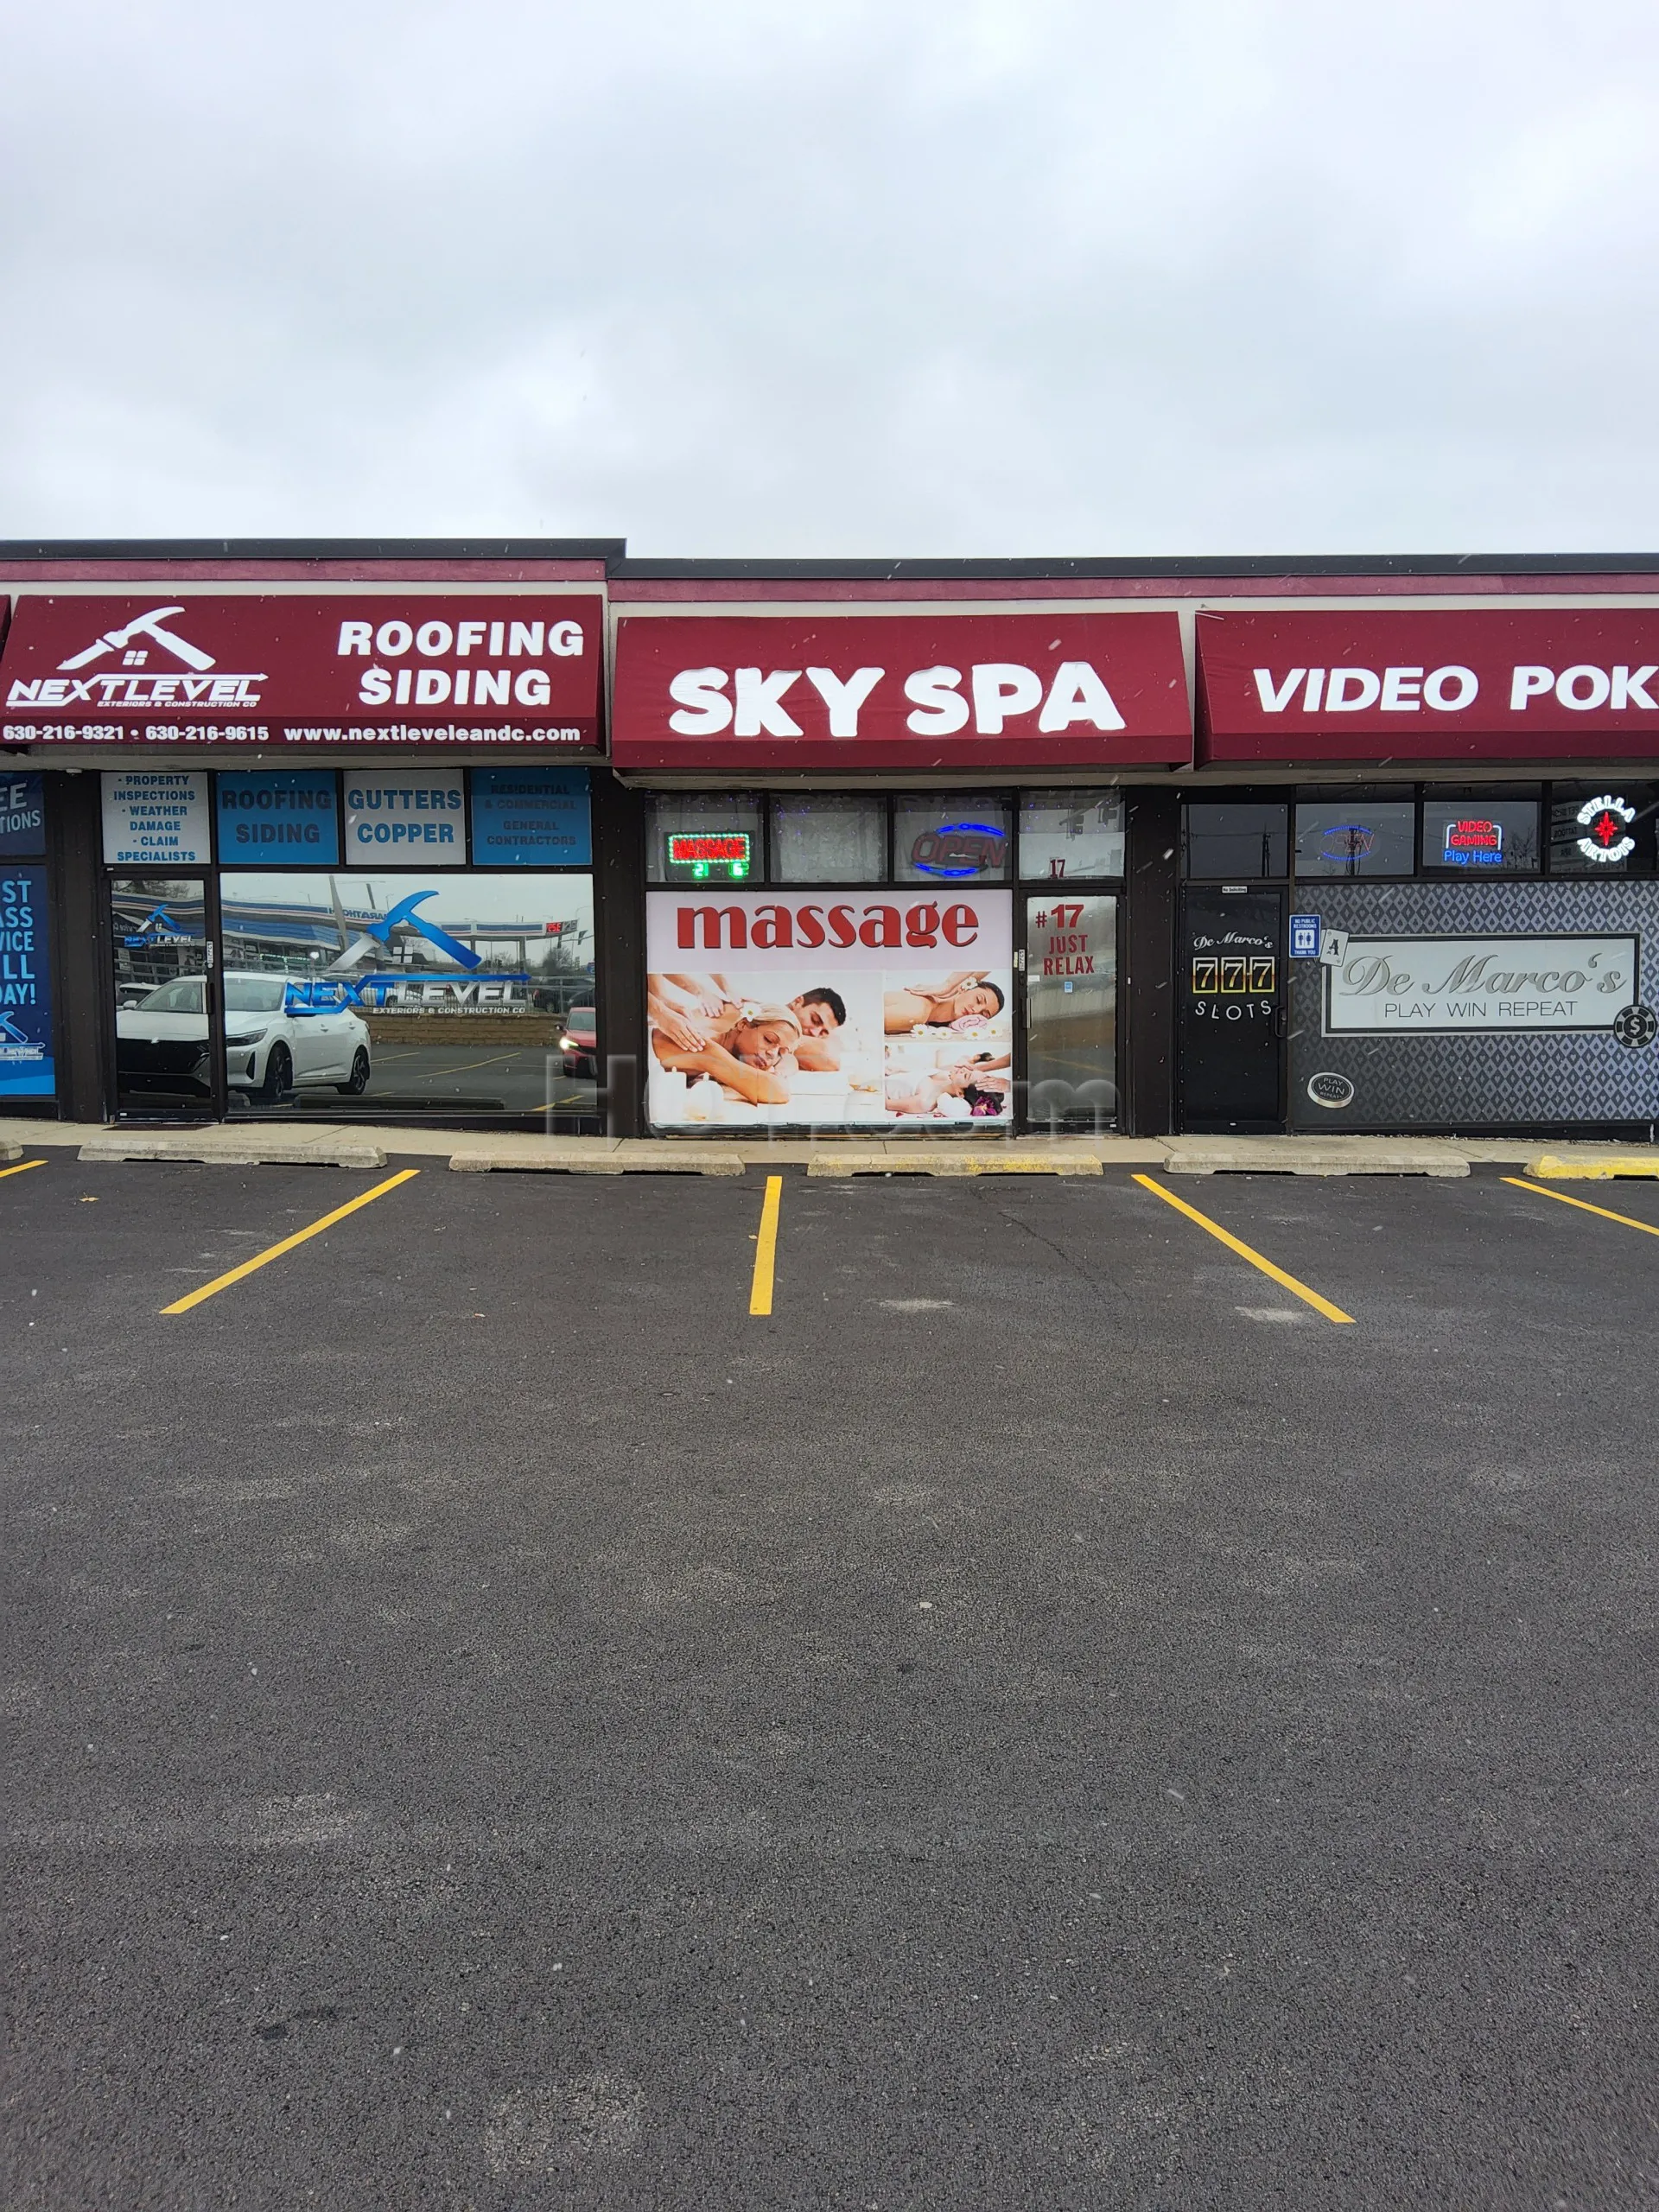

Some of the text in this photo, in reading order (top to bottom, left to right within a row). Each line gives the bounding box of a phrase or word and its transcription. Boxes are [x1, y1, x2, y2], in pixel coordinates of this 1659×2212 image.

[337, 620, 584, 657] ROOFING
[359, 668, 551, 705] SIDING
[1253, 664, 1478, 712] VIDEO
[669, 661, 1126, 737] SKY SPA
[3, 724, 581, 741] 630-216-9321 630-216-9615 www.nextleveleandc.com
[125, 775, 189, 785] PROPERTY
[491, 784, 570, 794] RESIDENTIAL
[113, 791, 195, 801] INSPECTIONS
[221, 790, 333, 810] ROOFING
[347, 789, 461, 810] GUTTERS
[498, 799, 577, 810] COMMERCIAL
[129, 806, 188, 816] WEATHER
[1577, 795, 1636, 825] STELLA
[130, 821, 181, 831] DAMAGE
[235, 823, 321, 843] SIDING
[357, 823, 454, 843] COPPER
[503, 821, 560, 830] GENERAL
[1457, 820, 1493, 833] VIDEO
[140, 836, 179, 846] CLAIM
[486, 836, 576, 846] CONTRACTORS
[672, 837, 746, 860] MASSAGE
[911, 831, 1007, 868] OPEN
[1319, 833, 1375, 853] OPEN
[1450, 834, 1497, 846] GAMING
[1577, 836, 1636, 862] ARTOIS
[117, 851, 196, 861] SPECIALISTS
[1444, 851, 1503, 864] Play Here
[1050, 858, 1066, 879] 17
[677, 900, 979, 950] massage
[1048, 934, 1089, 955] JUST
[1193, 931, 1274, 950] De Marco's
[1043, 956, 1095, 976] RELAX
[1339, 952, 1628, 996] De Marco's
[284, 980, 526, 1007] NEXTLEVEL
[1195, 1000, 1272, 1020] SLOTS
[1384, 1001, 1579, 1018] PLAY WIN REPEAT
[1318, 1082, 1345, 1096] WIN
[1323, 1077, 1344, 1086] PLAY
